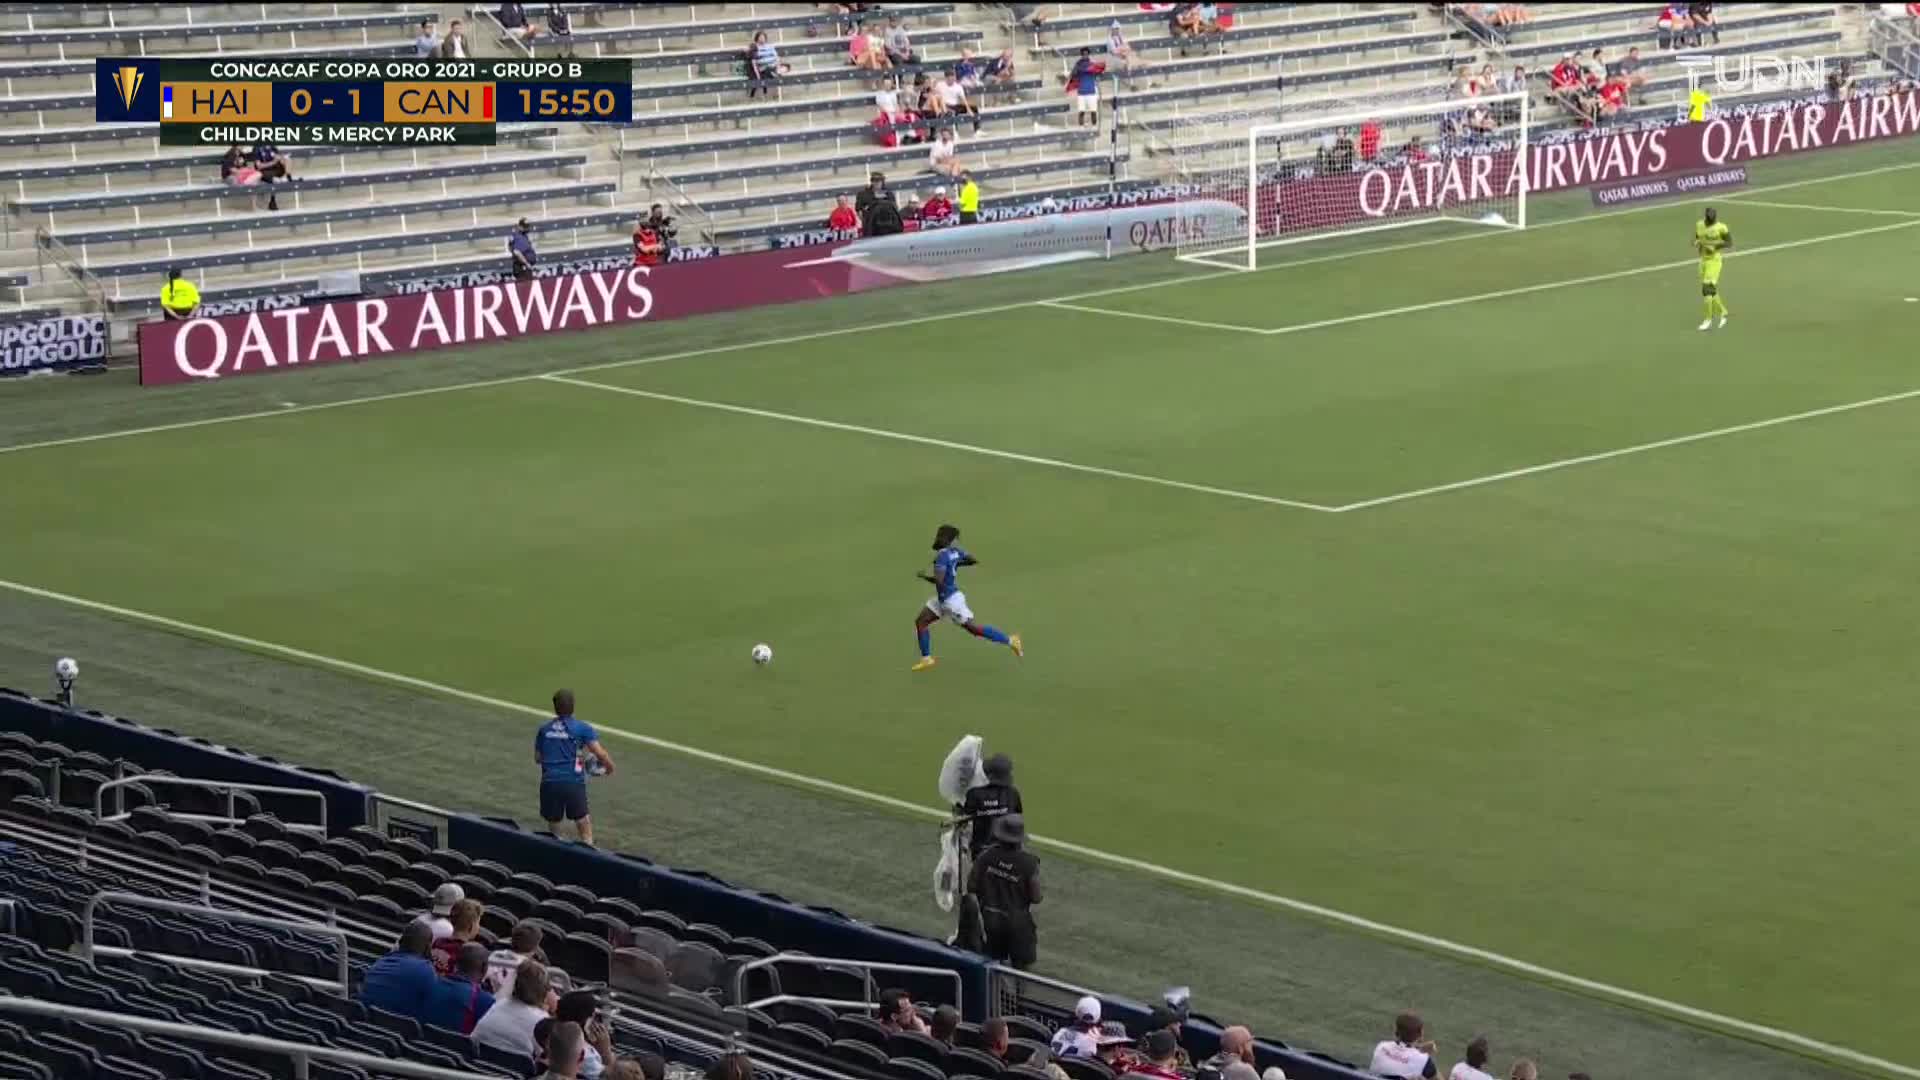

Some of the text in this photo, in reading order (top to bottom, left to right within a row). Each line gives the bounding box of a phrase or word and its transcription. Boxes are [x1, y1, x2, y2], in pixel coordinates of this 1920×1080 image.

[1701, 91, 1920, 165] QATAR AIRW
[1359, 128, 1667, 217] QATAR AIRWAYS
[1599, 181, 1669, 203] QATAR AIRWAYS
[1676, 169, 1746, 191] QATAR AIRWAYS
[1129, 213, 1207, 251] QATAR
[174, 265, 653, 378] QATAR AIRWAYS
